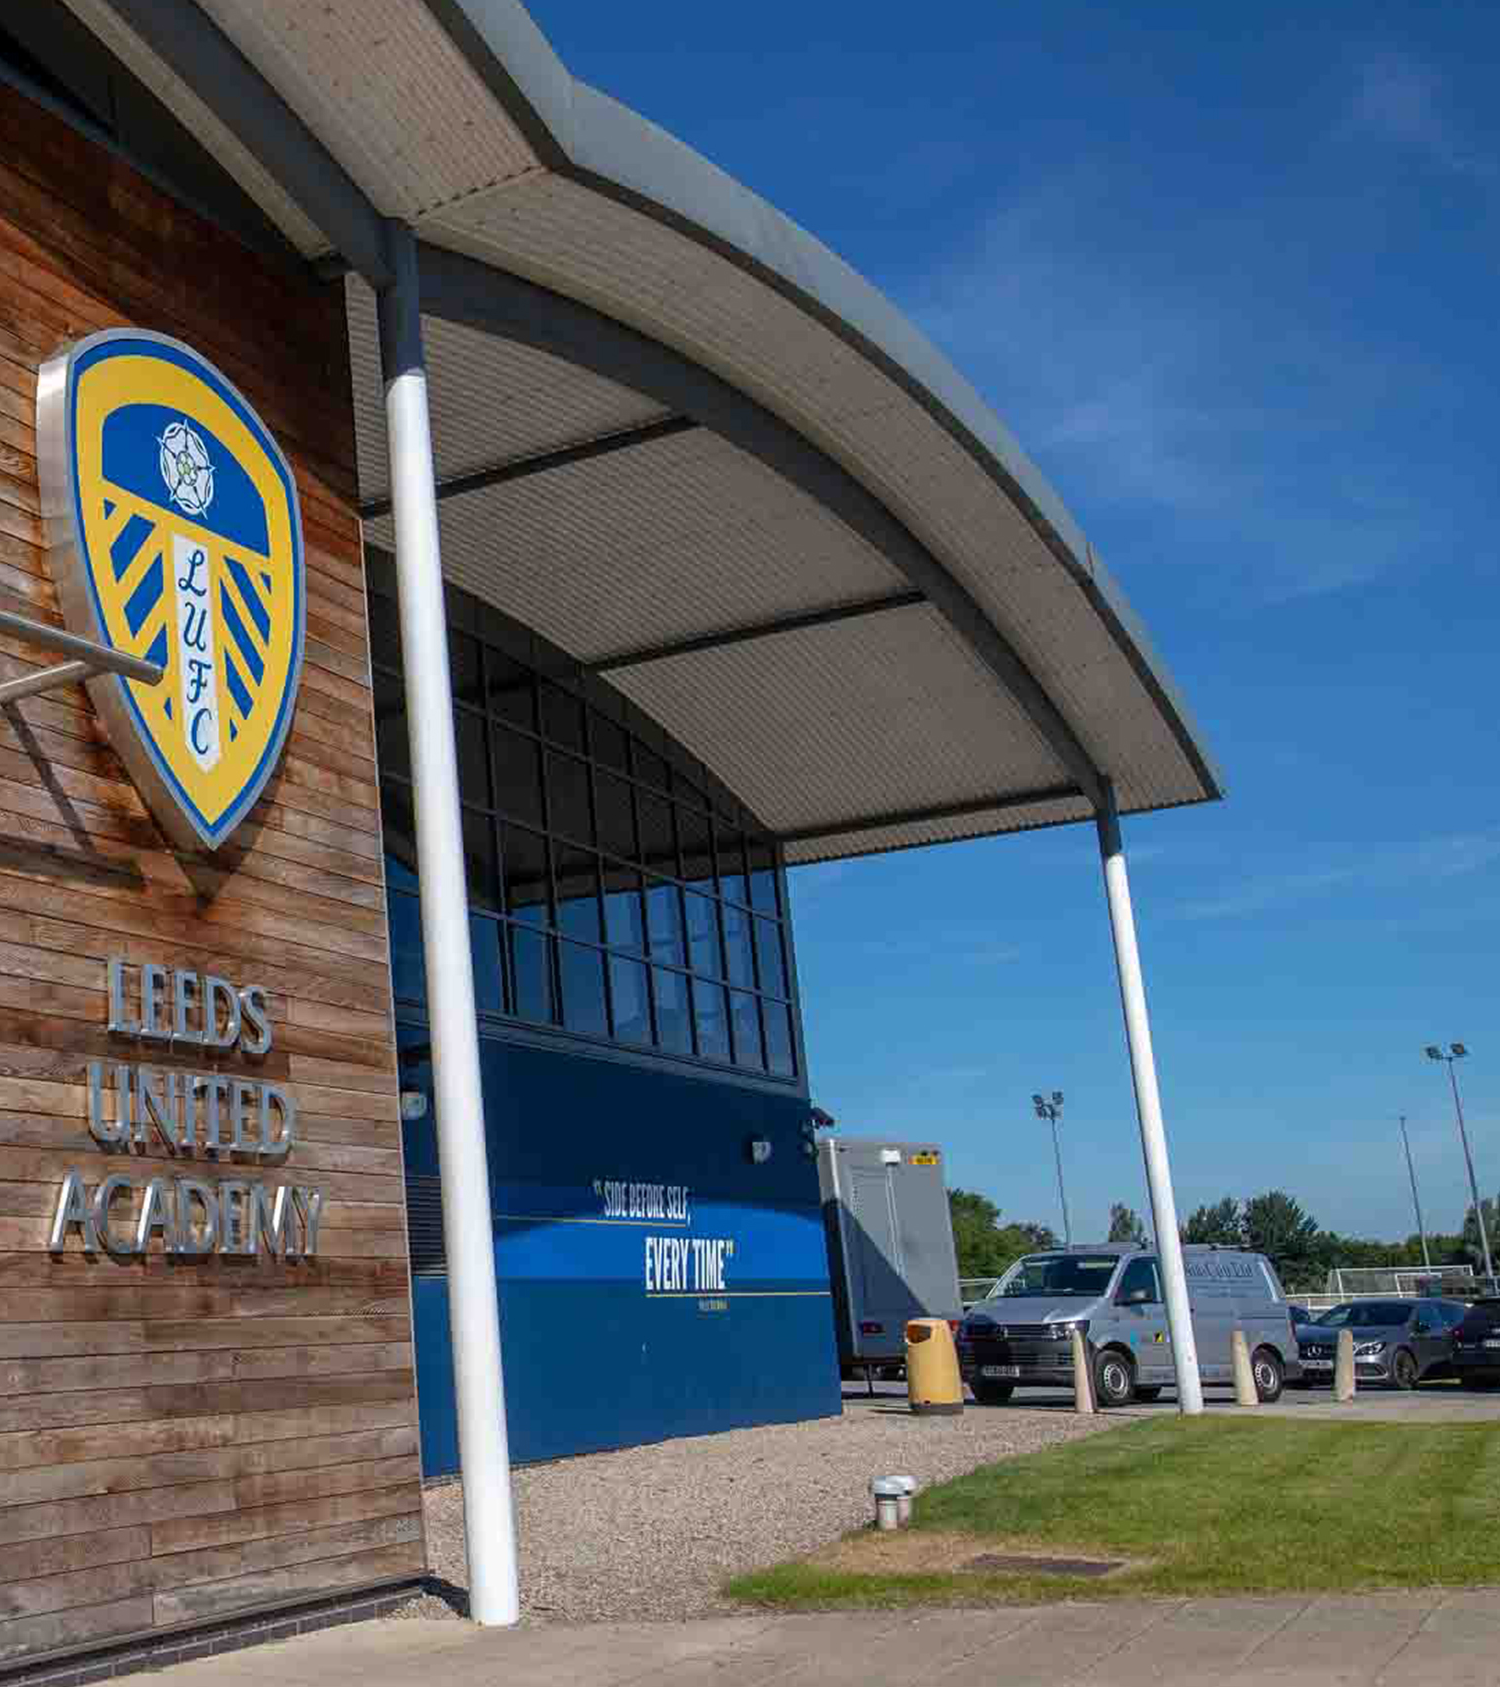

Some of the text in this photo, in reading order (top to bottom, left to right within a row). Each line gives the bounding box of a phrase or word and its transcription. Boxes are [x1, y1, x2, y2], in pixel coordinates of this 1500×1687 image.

[178, 549, 213, 756] LUFC
[107, 956, 273, 1053] LEEDS
[87, 1061, 296, 1154] UNITED
[50, 1167, 327, 1260] ACADEMY
[629, 1183, 665, 1219] BEFORE
[645, 1237, 689, 1290] EVERY
